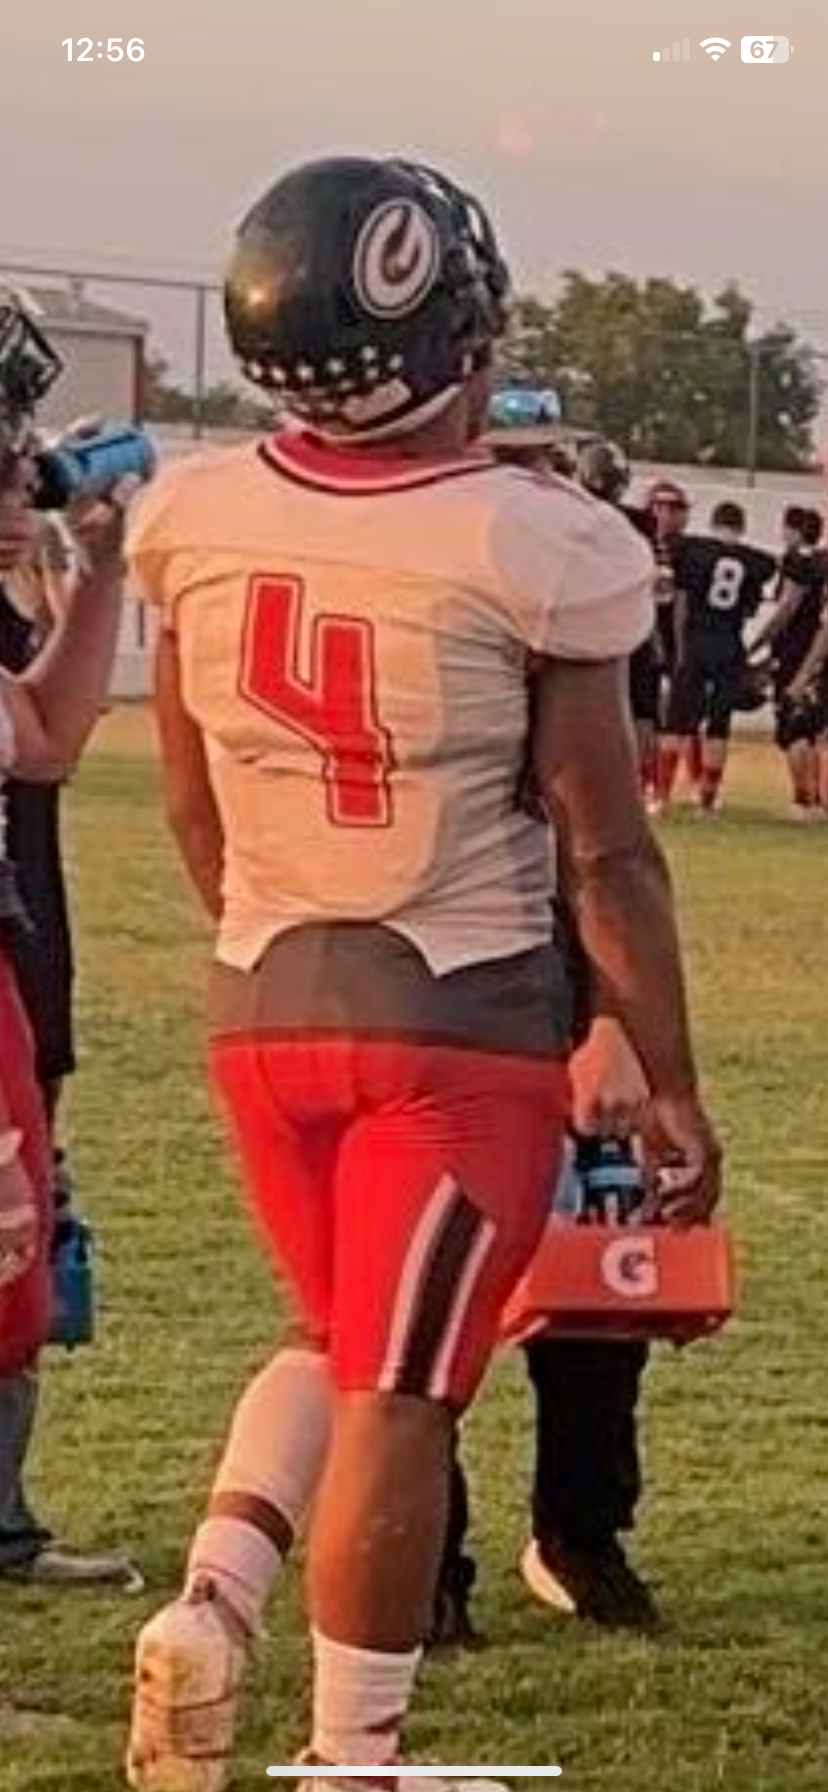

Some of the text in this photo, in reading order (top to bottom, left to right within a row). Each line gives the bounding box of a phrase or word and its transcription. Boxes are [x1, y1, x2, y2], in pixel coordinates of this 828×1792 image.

[709, 557, 744, 610] 8
[237, 573, 395, 829] 4
[601, 1235, 659, 1298] G
